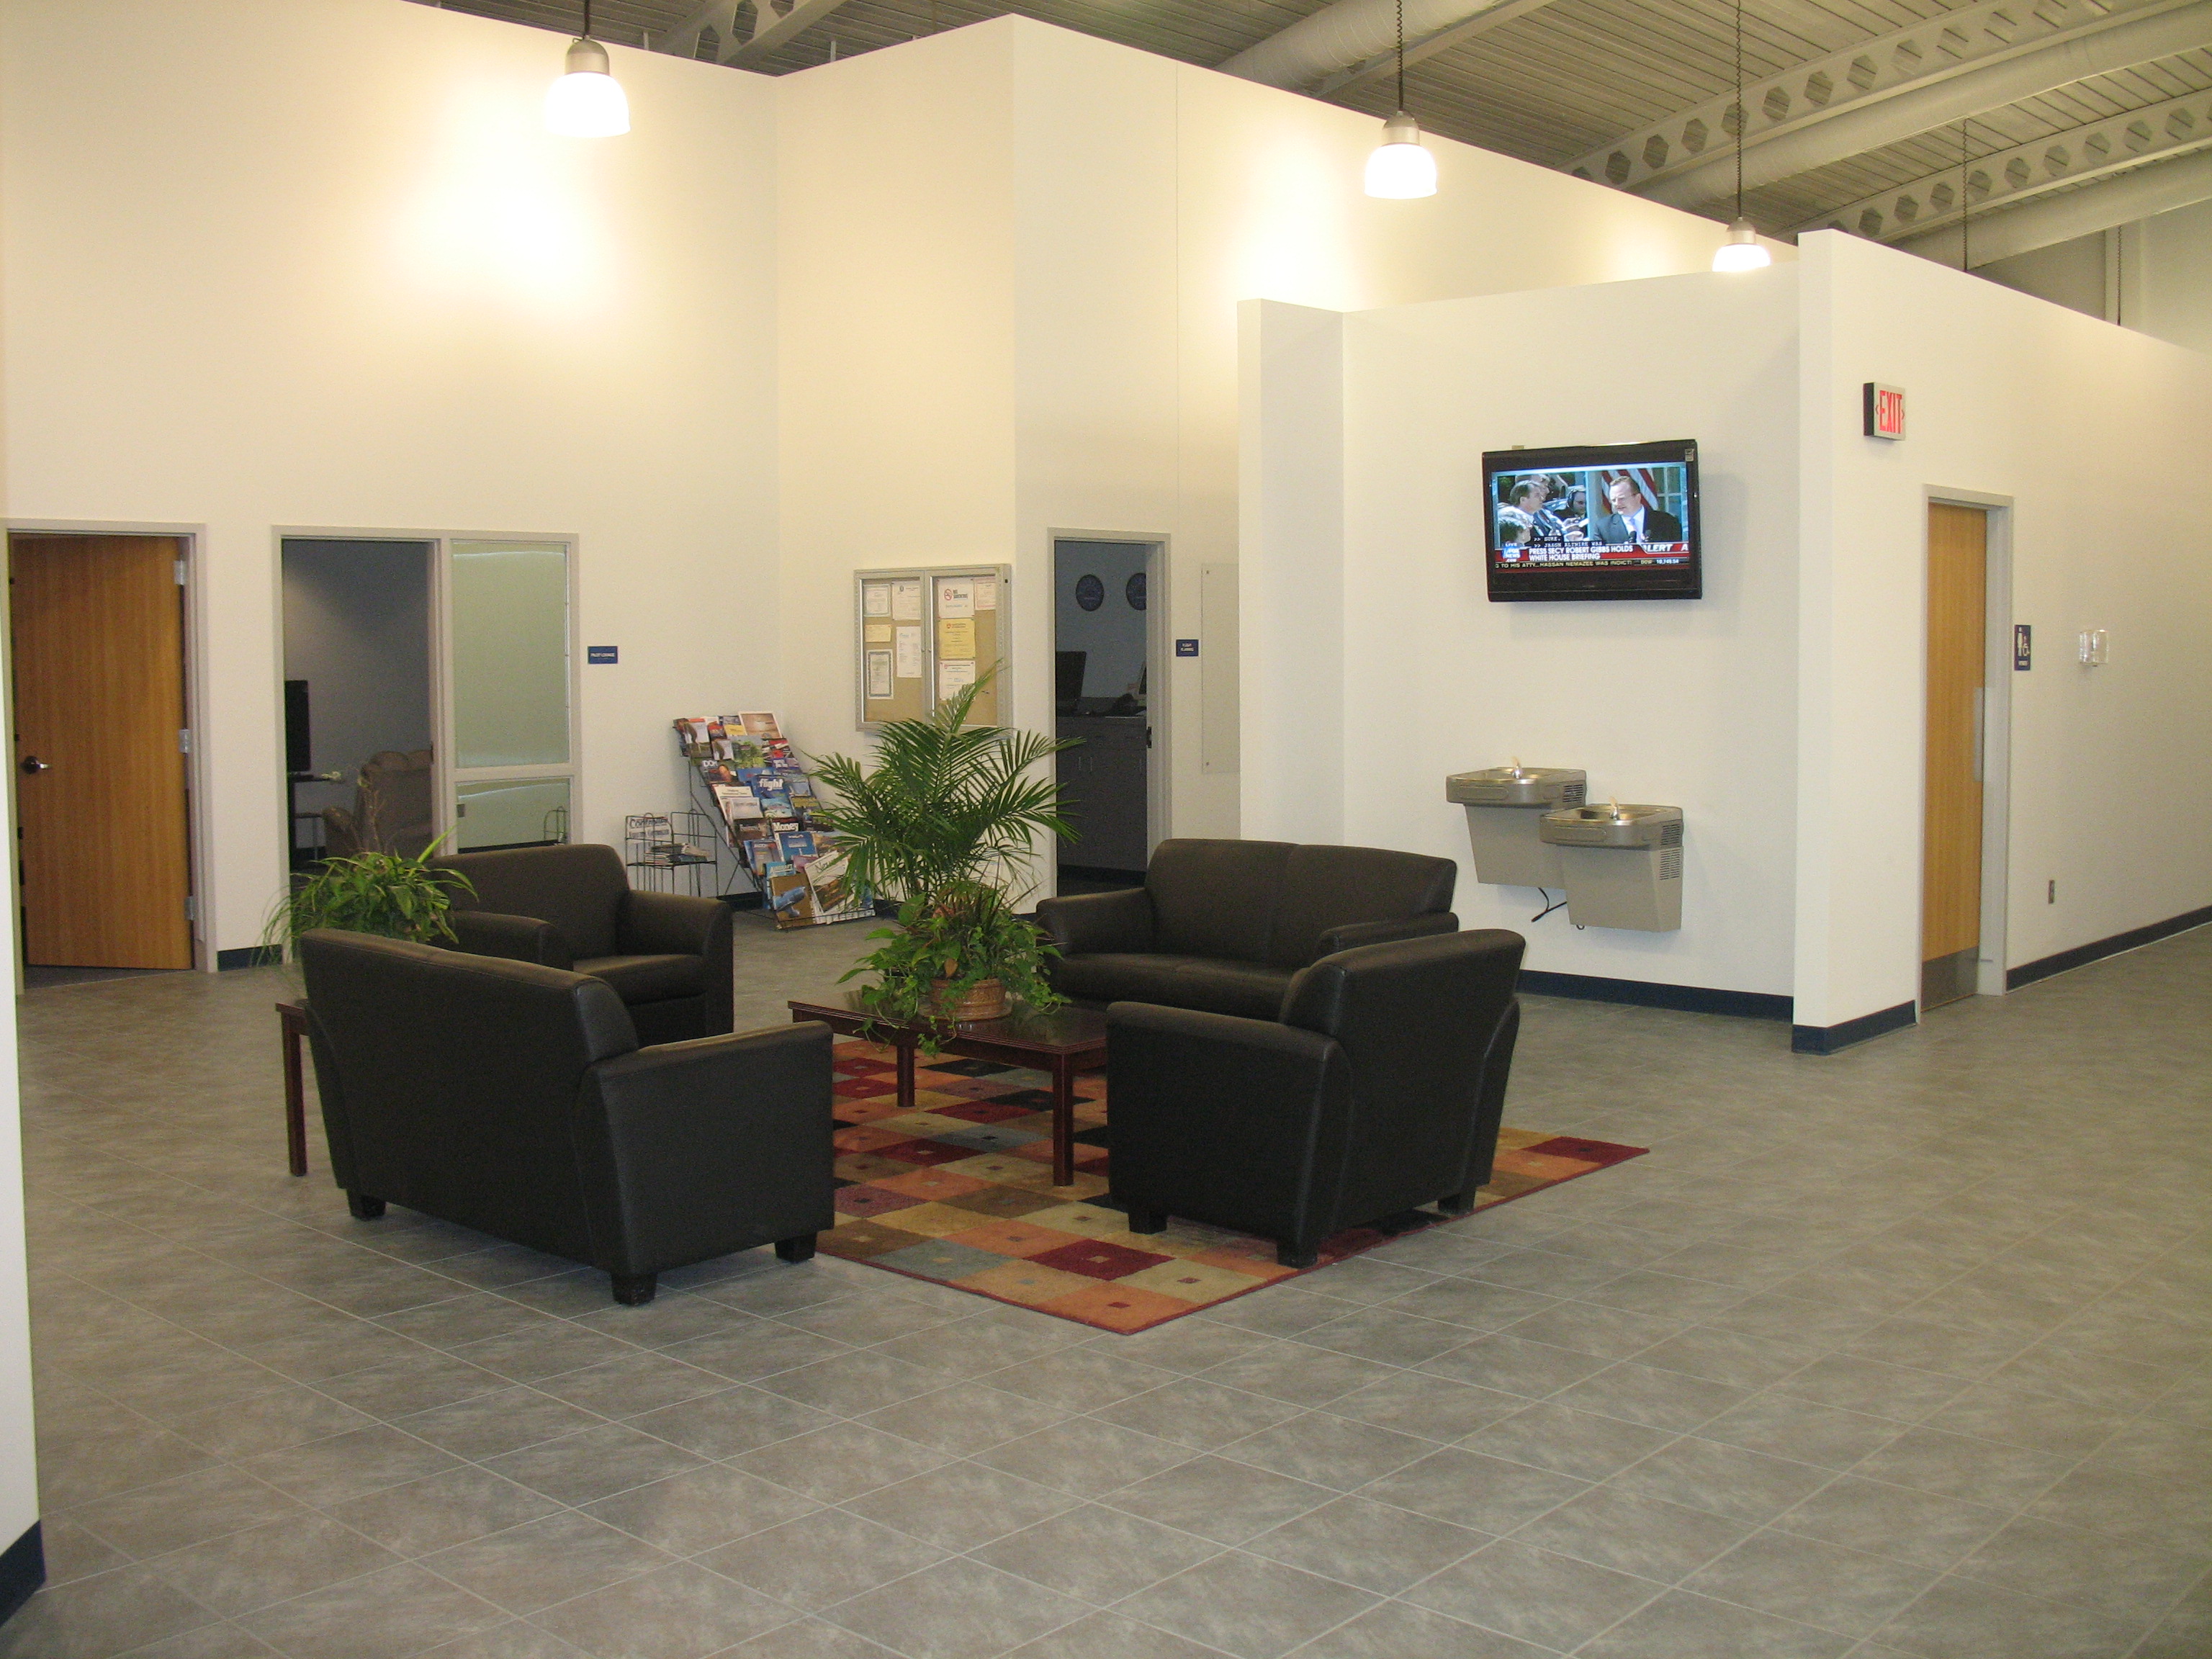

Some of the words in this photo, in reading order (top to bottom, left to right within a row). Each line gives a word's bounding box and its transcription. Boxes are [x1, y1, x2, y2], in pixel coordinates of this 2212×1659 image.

[1879, 390, 1902, 434] EXIT
[758, 778, 784, 791] flight
[771, 822, 799, 832] Money
